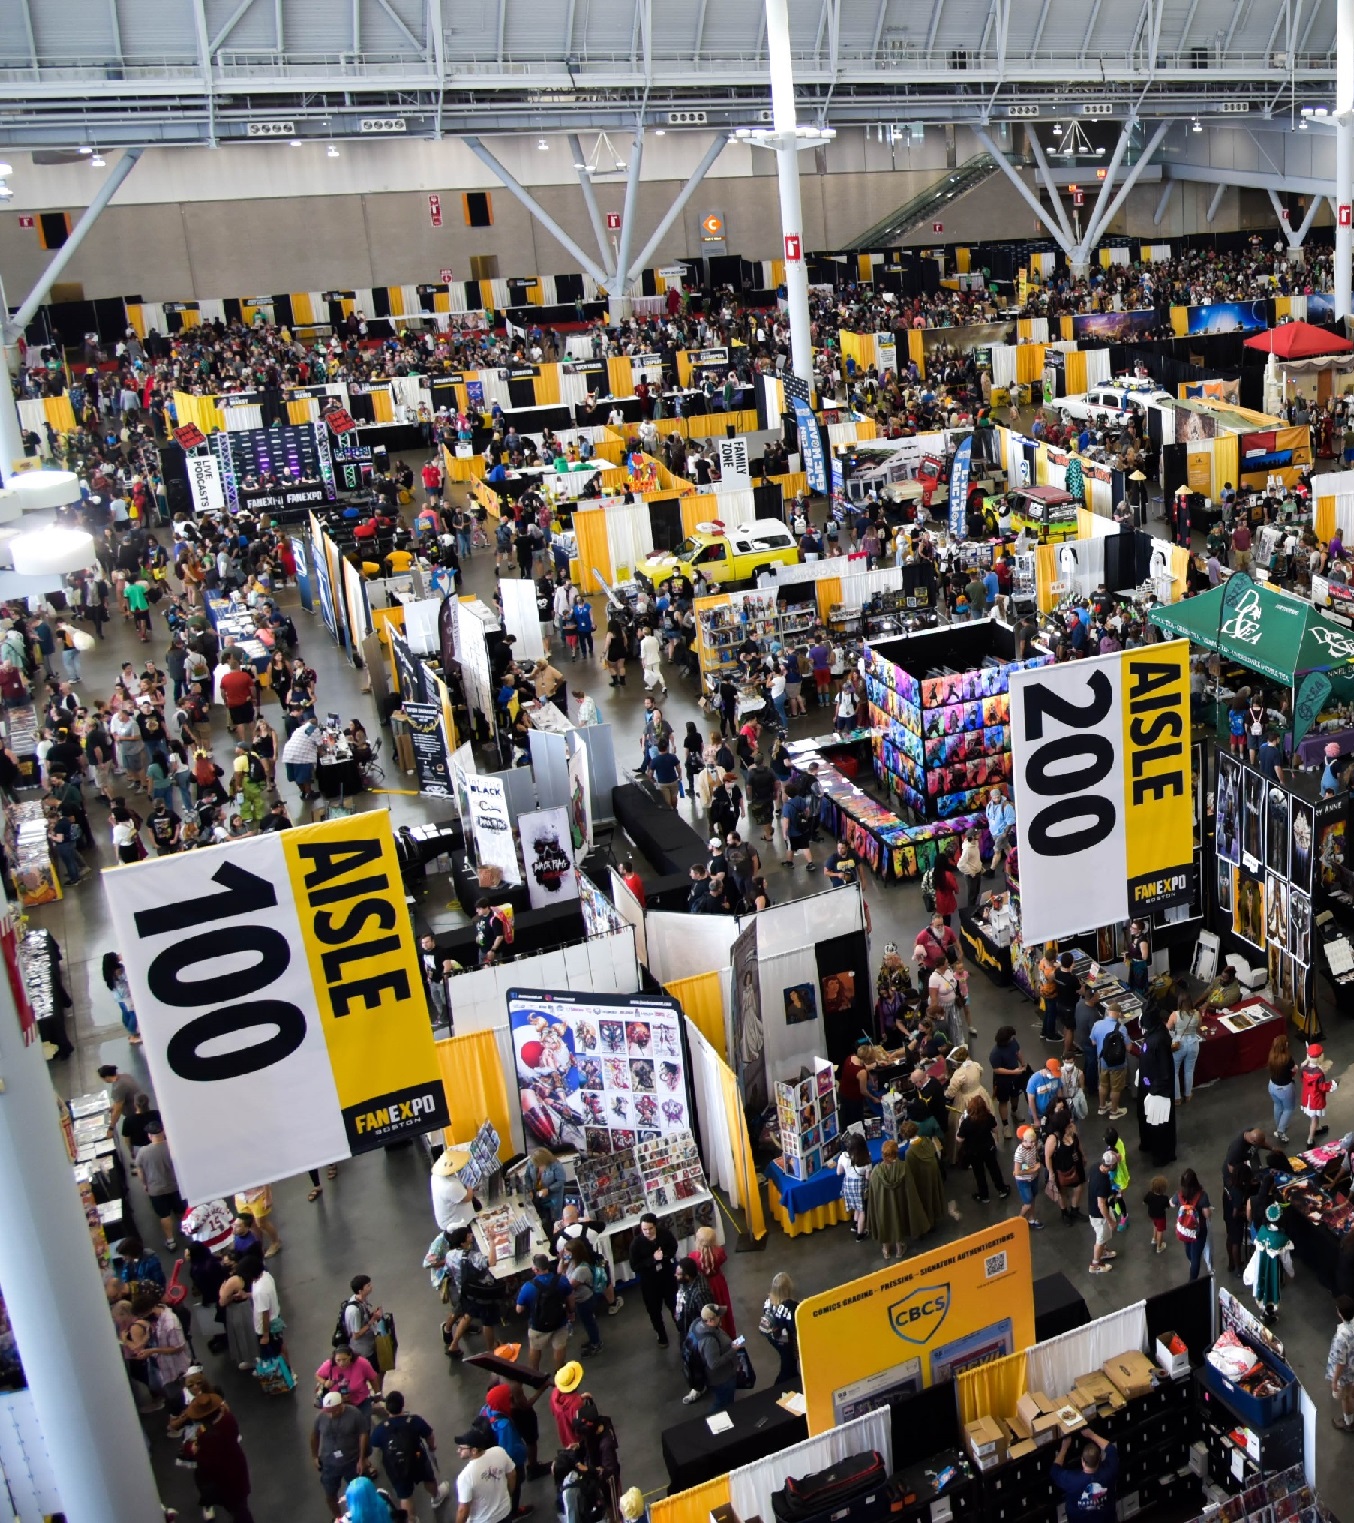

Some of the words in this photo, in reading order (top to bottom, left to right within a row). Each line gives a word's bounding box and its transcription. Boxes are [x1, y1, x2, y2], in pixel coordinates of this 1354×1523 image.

[708, 219, 717, 230] C
[202, 460, 213, 480] LIVE
[721, 443, 734, 467] ZONE
[734, 441, 747, 475] FAMILY
[193, 461, 210, 507] PODCASTS
[1129, 661, 1185, 807] AISLE
[1024, 669, 1116, 857] 200
[1134, 873, 1187, 902] FANEXPO
[297, 838, 412, 1019] AISLE
[133, 860, 308, 1082] 100
[355, 1094, 436, 1135] FANEXPO
[375, 1116, 422, 1136] BOSTON
[812, 1300, 842, 1318] COMICS
[842, 1289, 873, 1307] GRADING
[880, 1272, 914, 1292] PRESSING
[919, 1255, 956, 1277] SIGNATURE
[895, 1295, 946, 1327] CBCS
